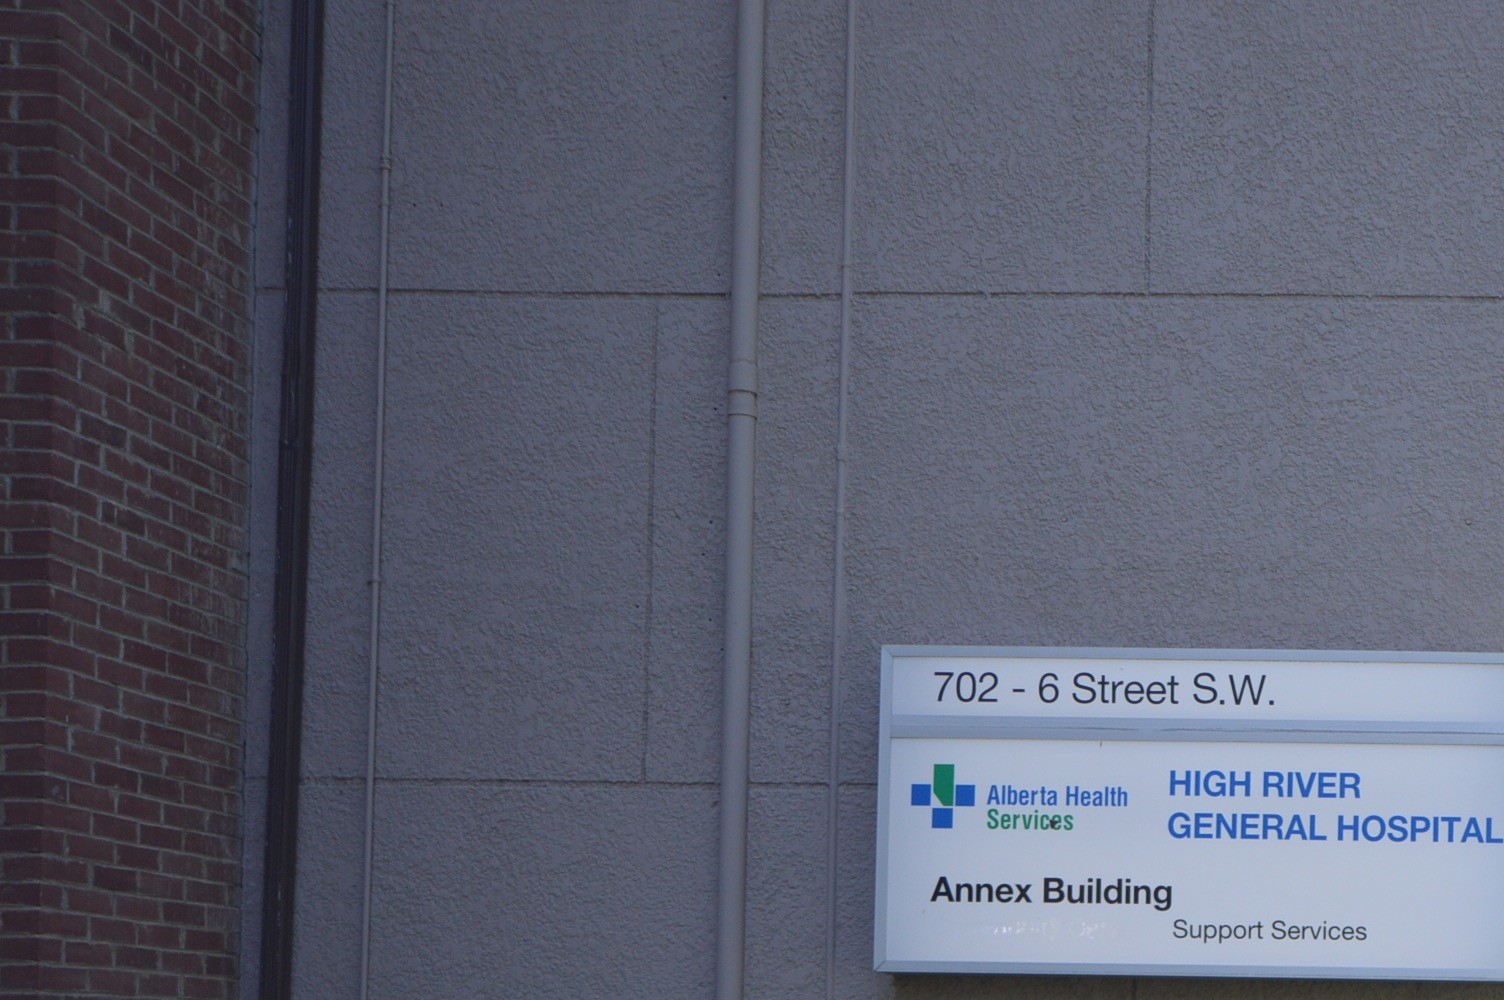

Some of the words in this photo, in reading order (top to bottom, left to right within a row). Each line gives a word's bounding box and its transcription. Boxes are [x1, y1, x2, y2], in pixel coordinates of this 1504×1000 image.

[933, 671, 999, 703] 702
[1037, 672, 1060, 705] 6
[1072, 672, 1179, 705] Street
[1192, 672, 1275, 706] S.W.
[986, 784, 1058, 807] Alberta
[1065, 785, 1128, 807] Health
[1168, 769, 1251, 798] HIGH
[1262, 771, 1361, 799] RIVER
[986, 808, 1074, 831] Services
[1167, 811, 1327, 841] GENERAL
[1336, 814, 1504, 844] HOSPITAL
[930, 876, 1032, 904] Annex
[1042, 877, 1173, 911] Building
[1172, 918, 1264, 944] Support
[1270, 919, 1368, 942] Services
